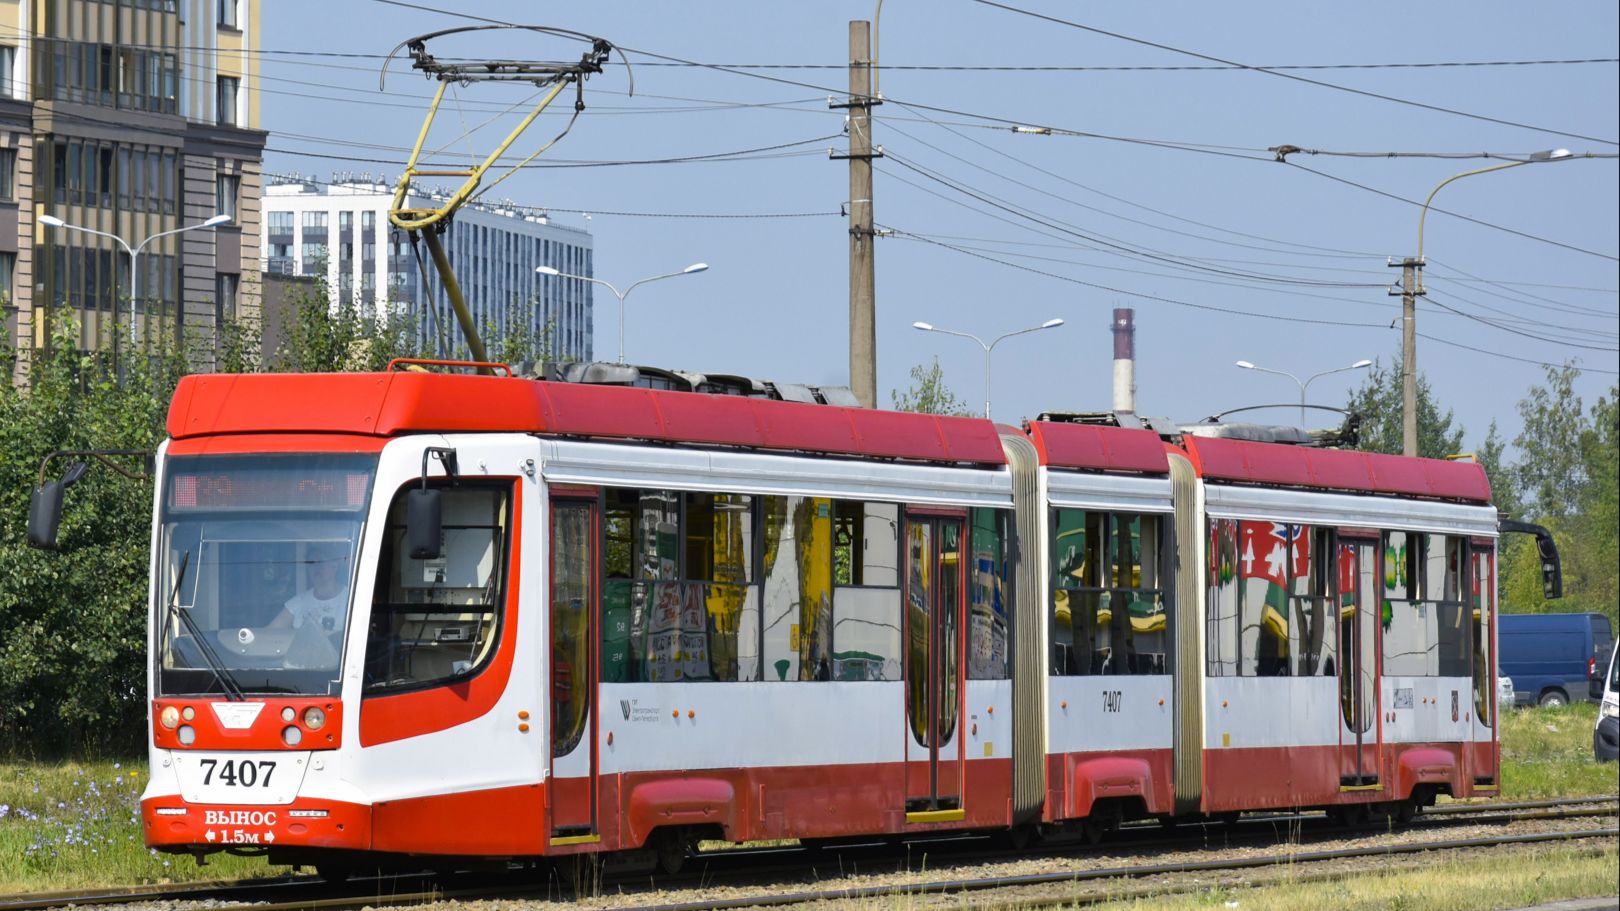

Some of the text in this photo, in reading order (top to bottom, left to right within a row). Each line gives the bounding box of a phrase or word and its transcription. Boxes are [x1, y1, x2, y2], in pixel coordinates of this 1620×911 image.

[1103, 691, 1121, 712] 7407
[200, 759, 276, 787] 7407
[204, 810, 277, 826] ВЫНОС
